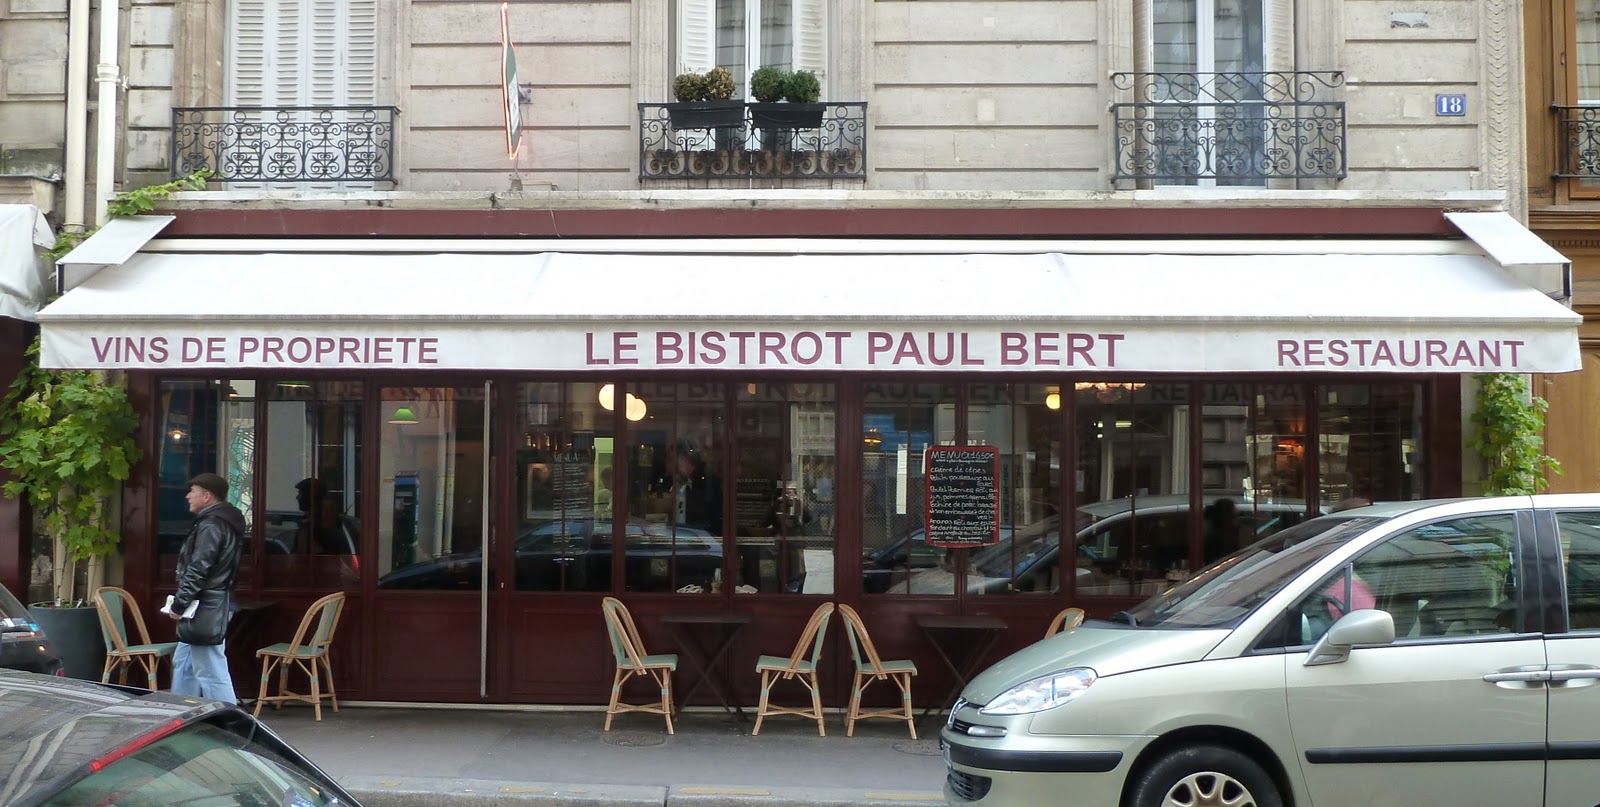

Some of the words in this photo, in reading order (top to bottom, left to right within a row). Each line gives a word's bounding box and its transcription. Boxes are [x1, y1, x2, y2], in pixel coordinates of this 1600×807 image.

[1440, 96, 1462, 113] 18
[92, 337, 168, 363] VINS
[182, 337, 226, 362] DE
[239, 337, 439, 364] PROPRIETE
[586, 331, 638, 365] LE
[656, 331, 852, 365] BISTROT
[868, 331, 985, 366] PAUL
[1001, 332, 1125, 367] BERT
[1277, 339, 1525, 368] RESTAURANT
[931, 451, 961, 460] MENU
[953, 500, 961, 508] de
